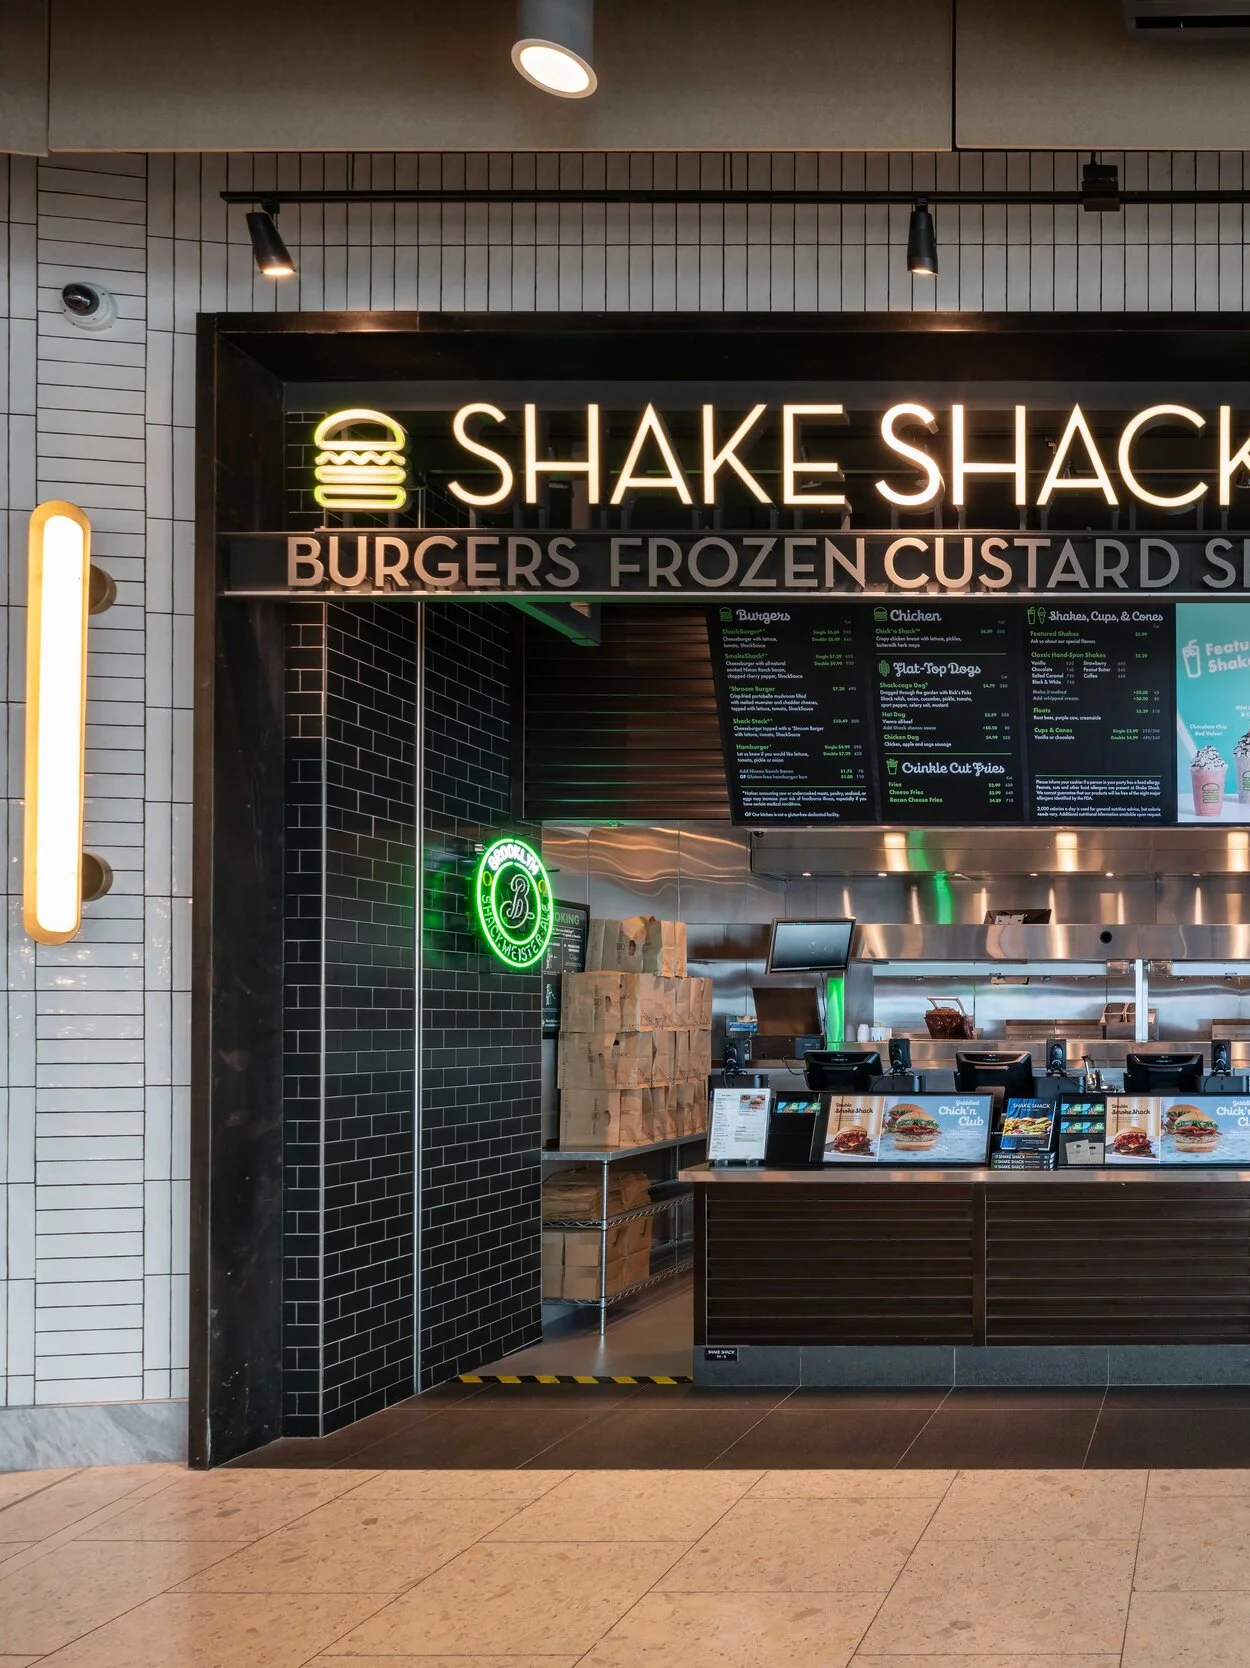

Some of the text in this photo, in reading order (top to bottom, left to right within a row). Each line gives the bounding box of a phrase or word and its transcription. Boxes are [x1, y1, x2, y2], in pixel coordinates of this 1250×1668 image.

[447, 401, 849, 507] SHAKE
[287, 535, 581, 588] BURGERS
[610, 535, 867, 588] FROZEN
[883, 537, 1180, 589] CUSTARD
[736, 609, 791, 624] Burgers
[890, 610, 942, 622] Chicken
[1049, 611, 1163, 623] Shakes, Cups, & Cones
[893, 663, 982, 677] Flat-Top Dogs
[902, 762, 1005, 776] Crinkle Cut Fries
[488, 844, 539, 875] BROOKLYN
[553, 910, 580, 925] OKING
[938, 1106, 976, 1115] Chick'n
[958, 1117, 984, 1126] Club
